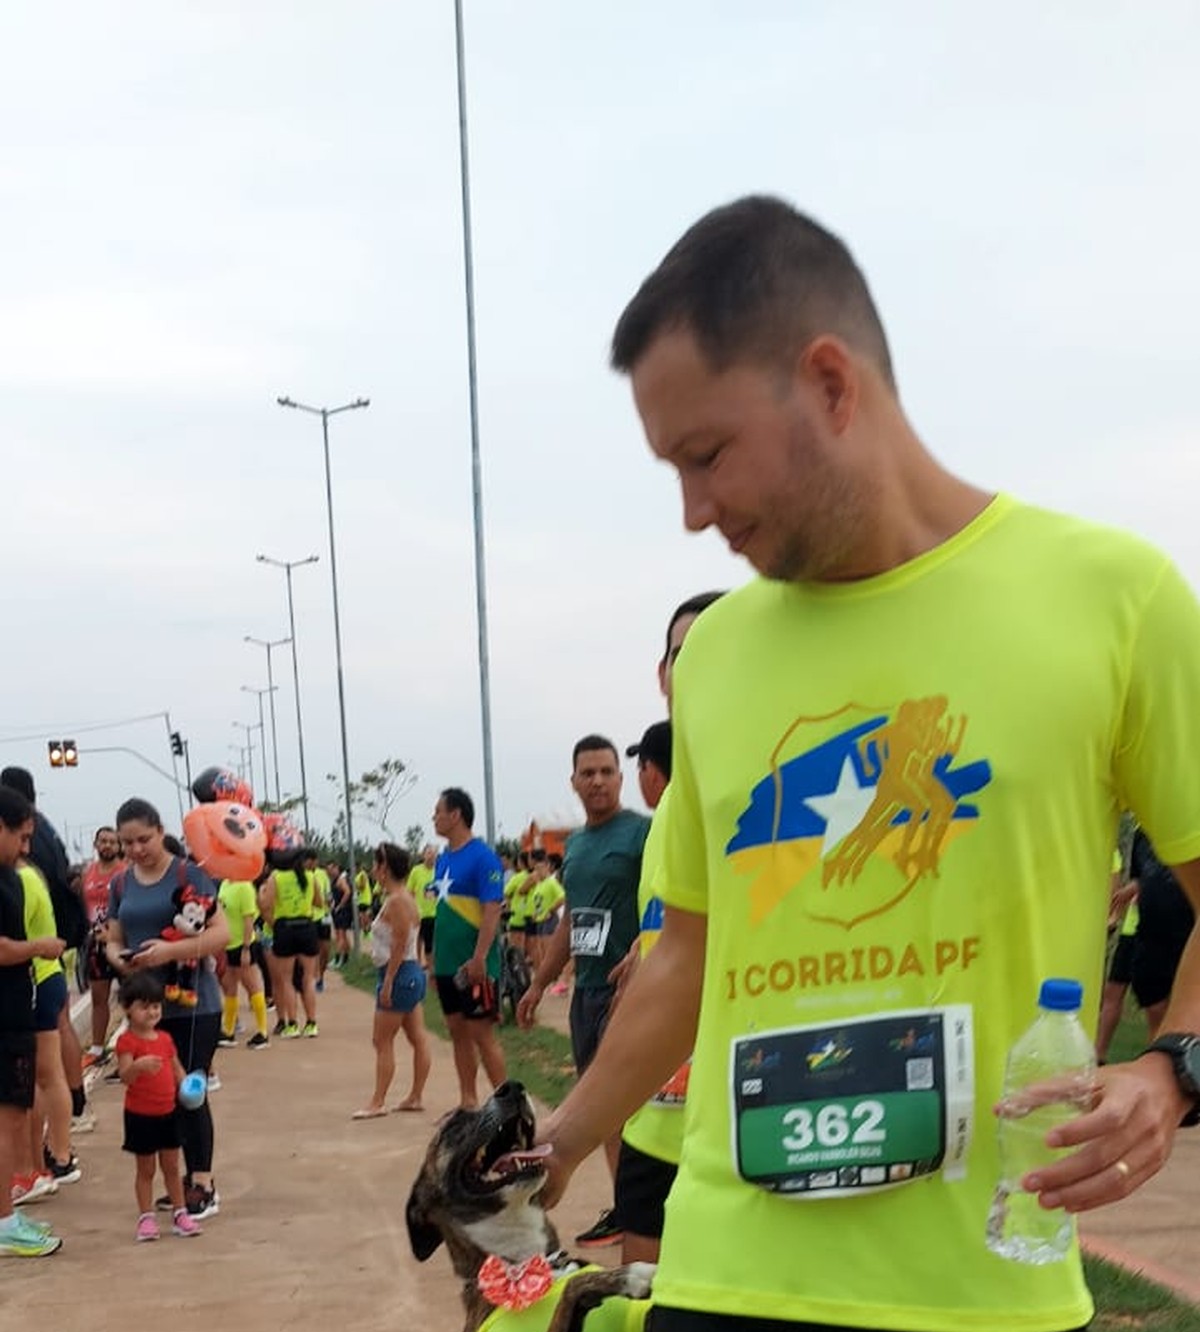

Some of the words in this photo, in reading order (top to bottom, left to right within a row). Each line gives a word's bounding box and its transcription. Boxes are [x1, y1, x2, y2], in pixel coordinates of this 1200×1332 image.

[726, 968, 737, 1000] I
[744, 943, 925, 997] CORRIDA
[935, 937, 981, 976] PF
[781, 1099, 887, 1151] 362
